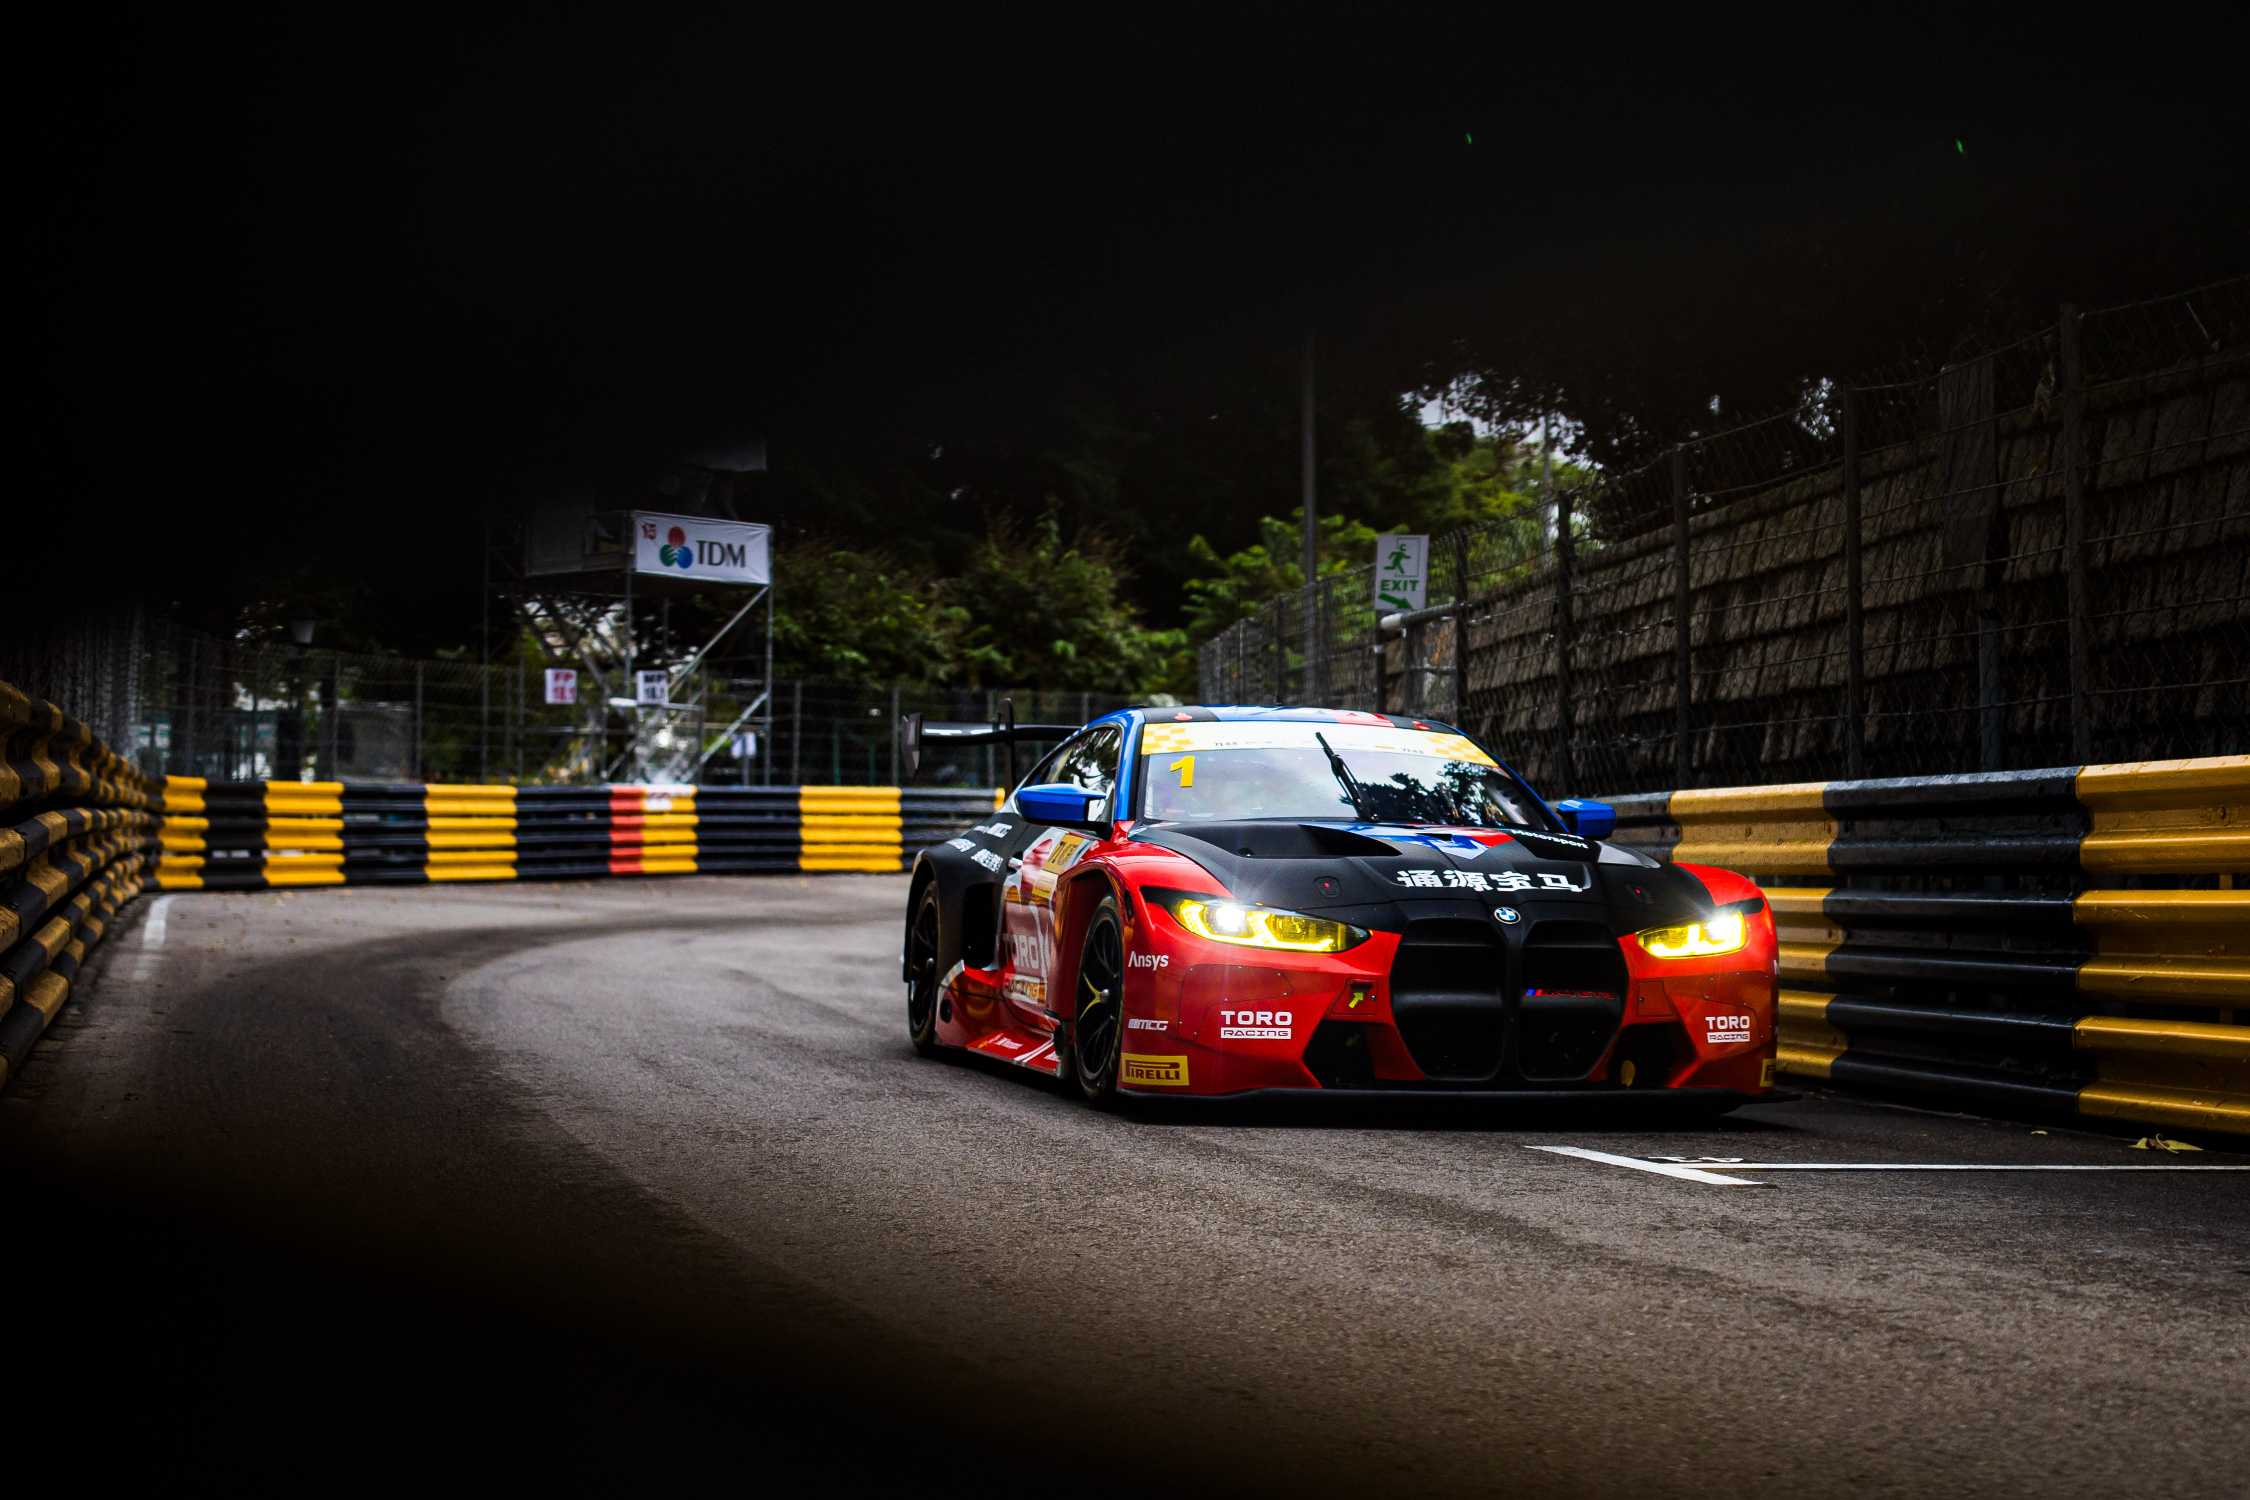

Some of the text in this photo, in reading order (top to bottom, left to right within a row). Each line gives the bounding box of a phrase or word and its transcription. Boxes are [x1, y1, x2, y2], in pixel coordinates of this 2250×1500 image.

[696, 540, 746, 568] TDM
[1380, 580, 1419, 592] EXIT
[1169, 755, 1195, 787] 1
[1397, 870, 1584, 892] 通源宝马
[1128, 951, 1169, 971] Ansys
[1220, 1010, 1293, 1026] TORO
[1705, 1016, 1751, 1030] TORO
[1223, 1029, 1289, 1037] RACING
[1125, 1060, 1181, 1081] PIRELLI
